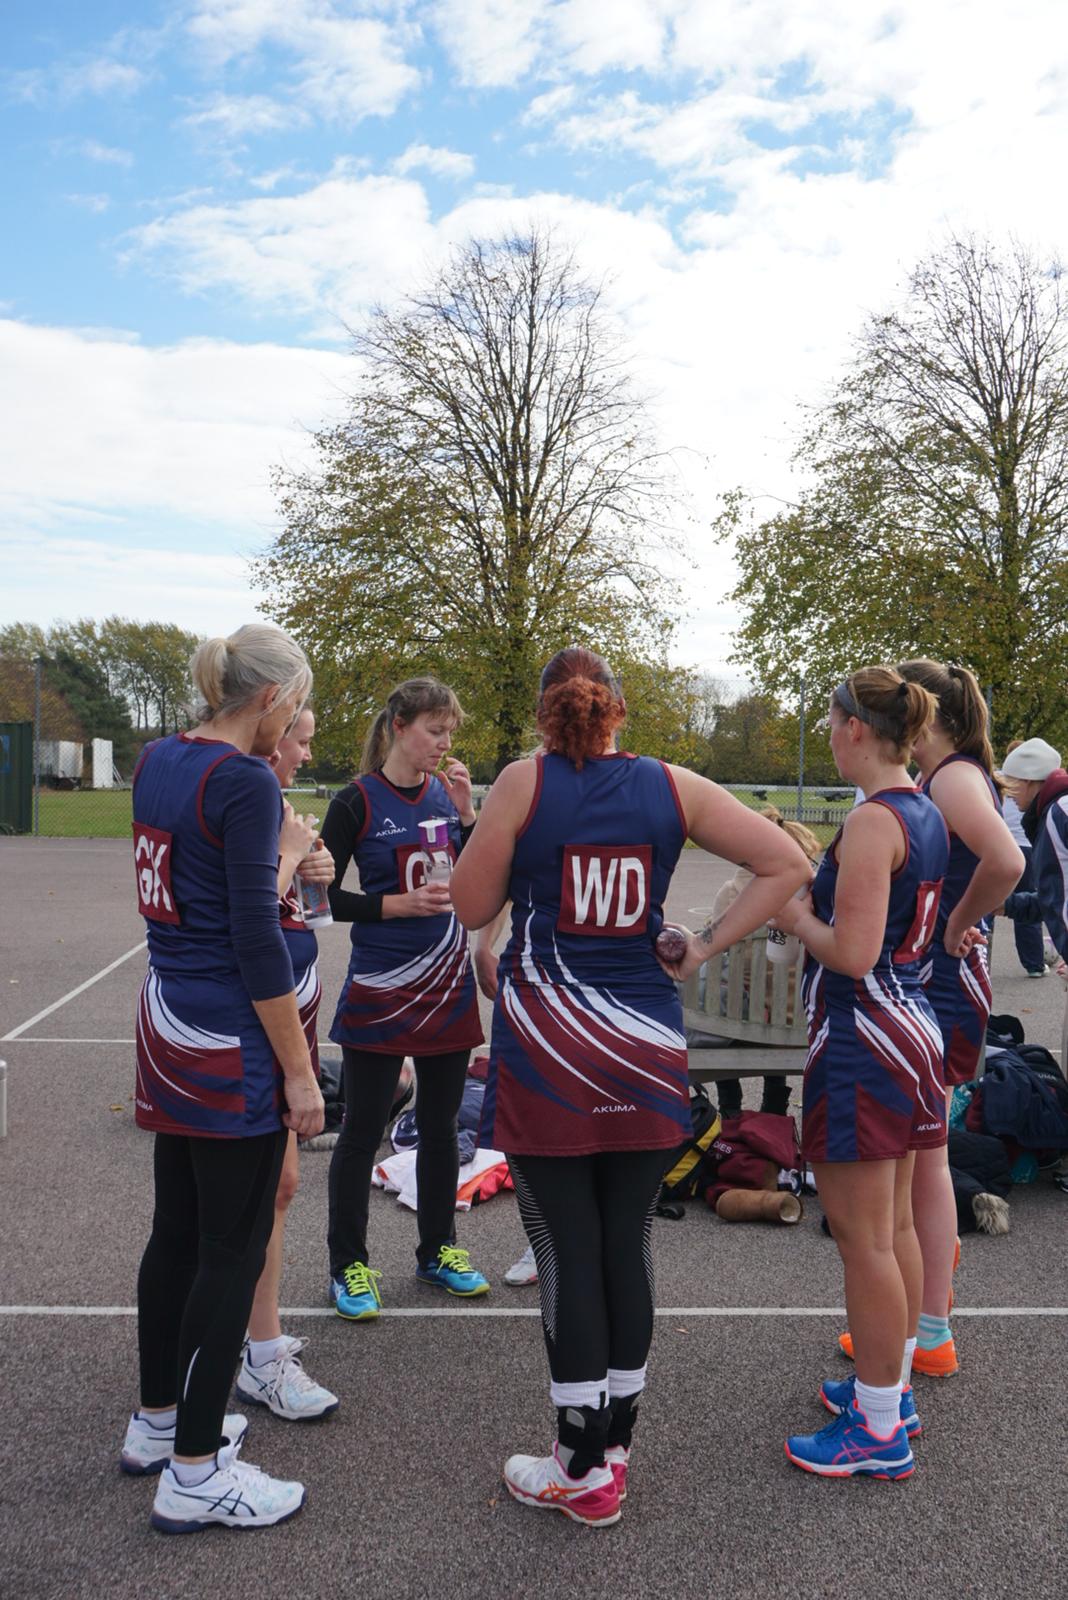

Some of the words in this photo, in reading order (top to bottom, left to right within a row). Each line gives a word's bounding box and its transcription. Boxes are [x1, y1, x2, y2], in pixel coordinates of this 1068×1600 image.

[376, 826, 407, 837] AKUMA
[135, 835, 172, 912] GK
[571, 855, 646, 928] WD
[592, 1104, 638, 1113] AKUMA
